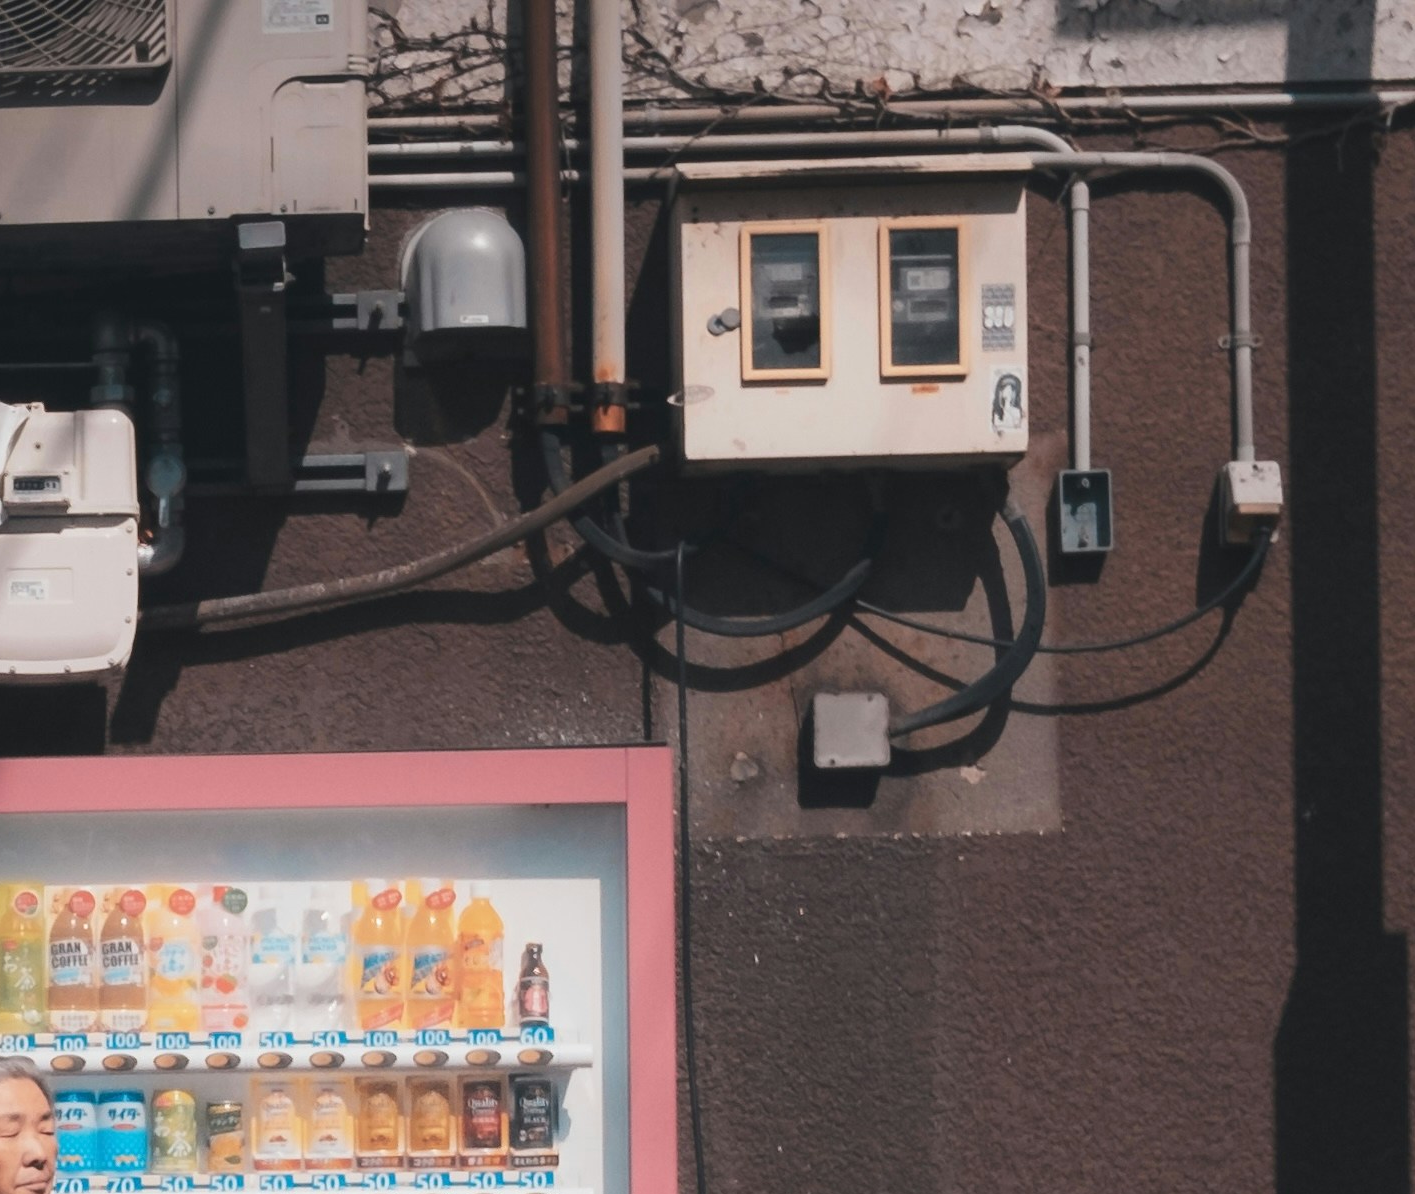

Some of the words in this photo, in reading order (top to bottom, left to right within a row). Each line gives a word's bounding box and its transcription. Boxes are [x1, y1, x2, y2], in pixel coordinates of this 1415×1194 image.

[51, 941, 81, 954] GRAN
[102, 941, 132, 954] GRAN
[1, 1035, 28, 1051] 80
[106, 1034, 138, 1048] 100
[156, 1034, 186, 1049] 100
[208, 1035, 238, 1049] 100
[259, 1032, 286, 1047] 50
[312, 1032, 340, 1047] 50
[364, 1032, 393, 1046] 100
[416, 1030, 446, 1045] 100
[468, 1030, 497, 1045] 100
[520, 1027, 545, 1044] 60
[54, 1037, 84, 1051] 100
[57, 1178, 83, 1193] 70
[107, 1178, 135, 1193] 70
[161, 1177, 188, 1191] 50
[210, 1175, 236, 1190] 50
[260, 1176, 286, 1191] 50
[313, 1175, 339, 1190] 50
[363, 1174, 389, 1189] 50
[416, 1174, 443, 1189] 50
[469, 1173, 496, 1189] 50
[520, 1172, 547, 1188] 50
